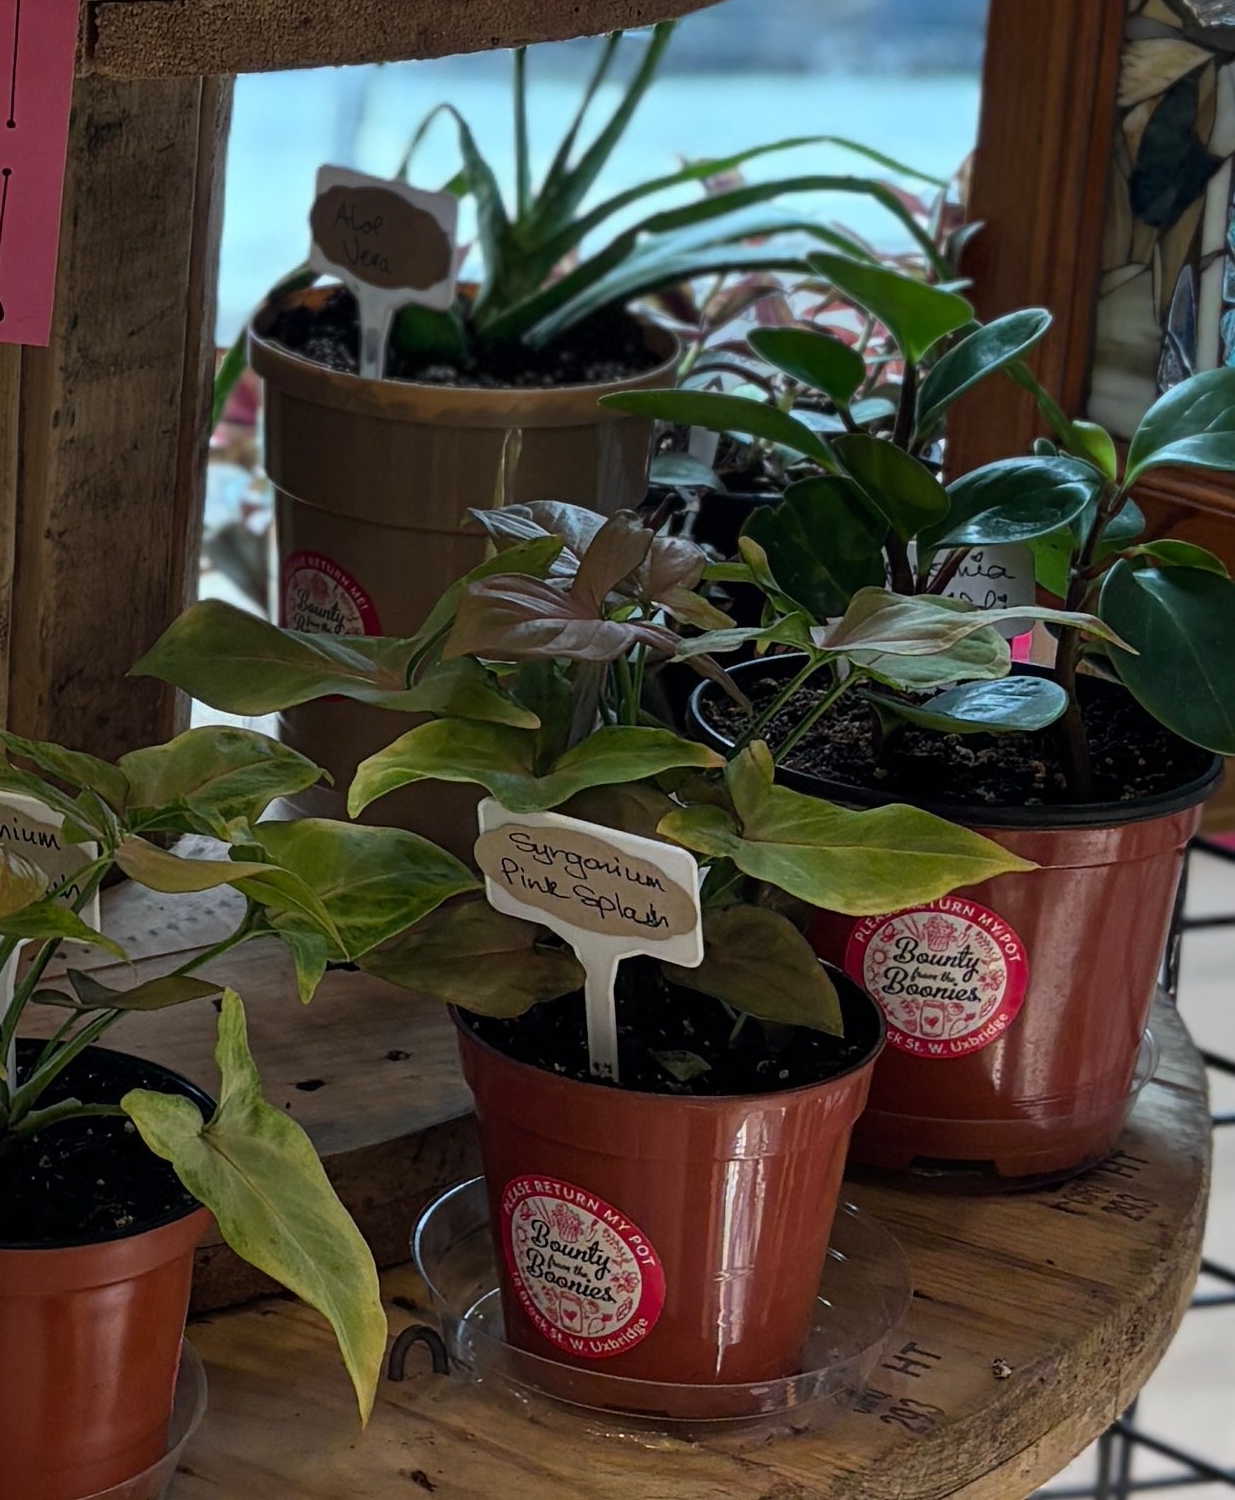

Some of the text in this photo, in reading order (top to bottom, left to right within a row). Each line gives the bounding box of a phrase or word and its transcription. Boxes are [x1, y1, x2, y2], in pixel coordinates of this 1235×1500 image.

[342, 235, 392, 275] Vera
[297, 588, 345, 634] Bounty
[501, 858, 669, 928] Pink Splash
[893, 936, 980, 982] Bounty
[978, 913, 1001, 932] MY
[999, 933, 1021, 962] POT
[881, 966, 982, 1003] Boonies
[910, 967, 956, 983] from the
[928, 1043, 948, 1054] W.
[951, 1013, 1009, 1053] Uxbridge
[534, 1180, 599, 1211] RETURN
[603, 1209, 631, 1232] MY
[628, 1234, 656, 1267] POT
[531, 1219, 611, 1281] Bounty
[547, 1254, 588, 1278] from the
[526, 1247, 617, 1304] Boonies
[569, 1337, 587, 1351] W.
[589, 1318, 648, 1353] Uxbridge
[881, 1341, 942, 1378] HT
